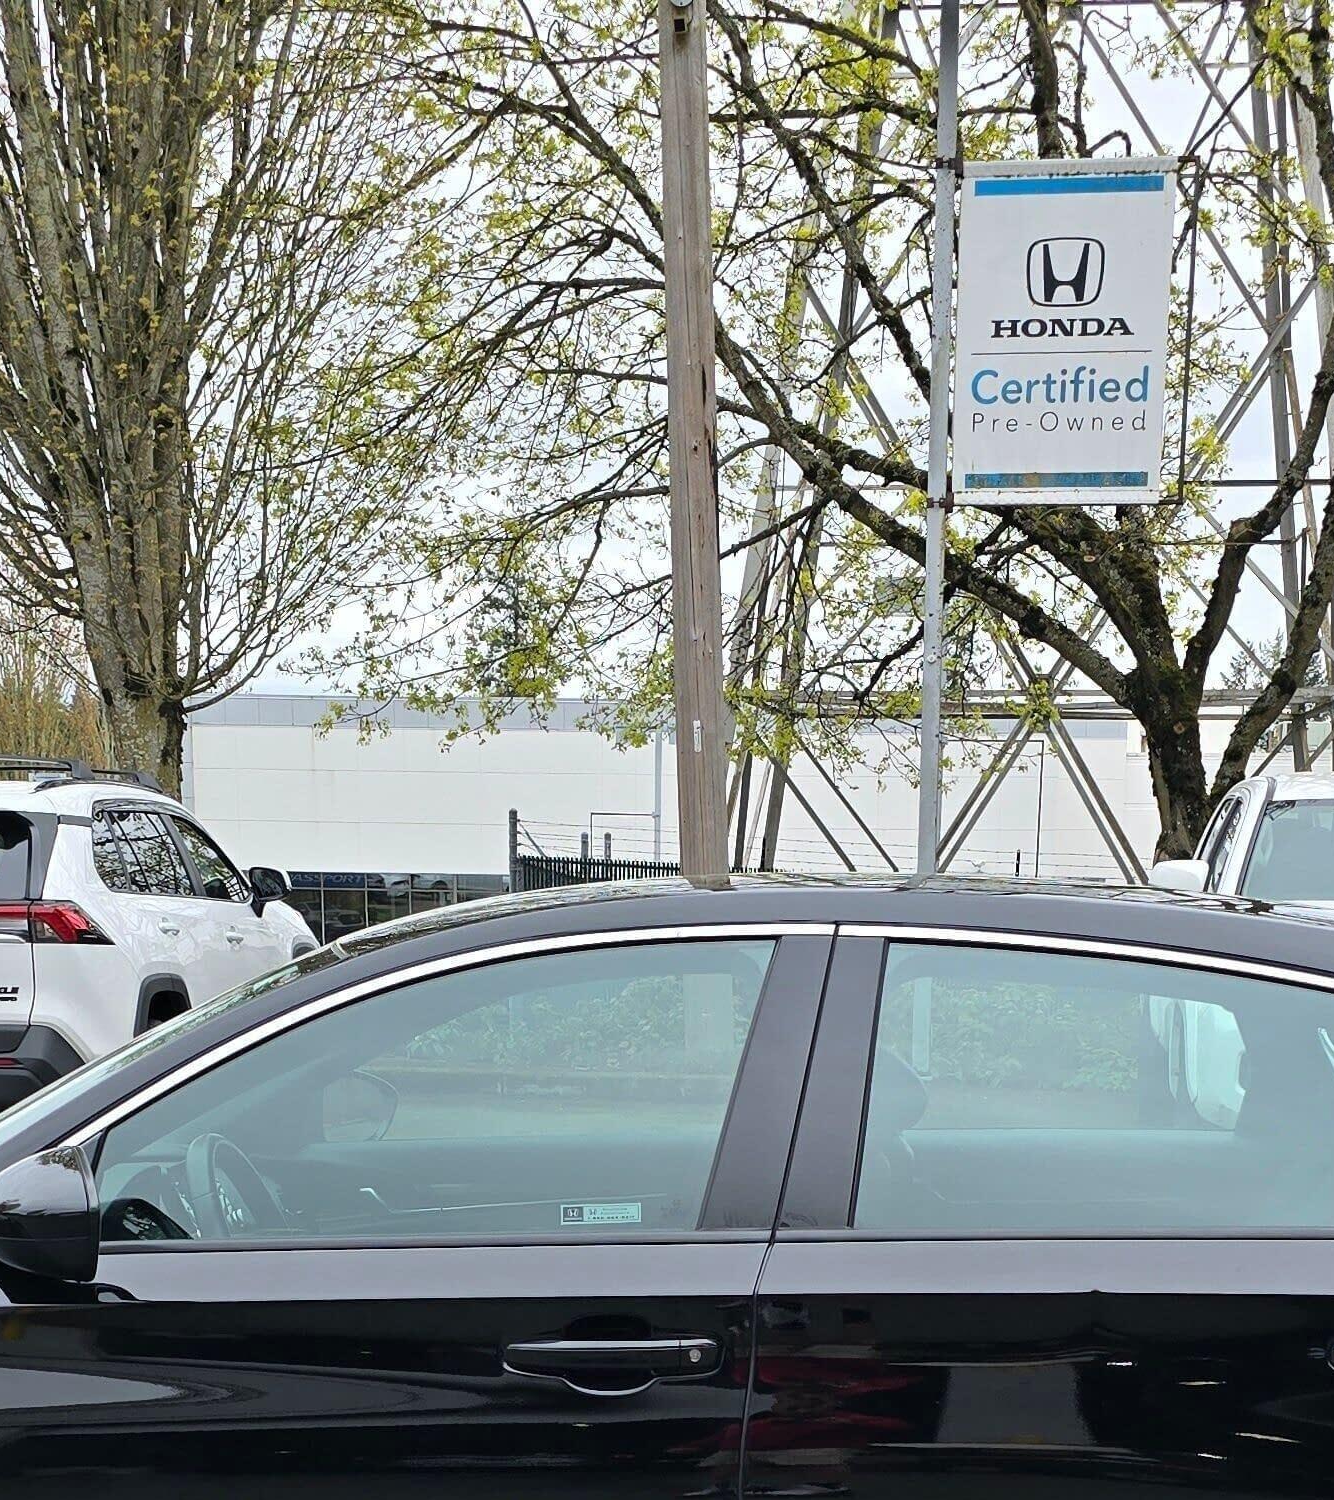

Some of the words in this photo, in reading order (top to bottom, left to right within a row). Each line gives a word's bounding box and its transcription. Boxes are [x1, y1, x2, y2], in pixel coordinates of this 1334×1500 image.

[991, 317, 1134, 338] HONDA
[971, 365, 1149, 405] Certified
[971, 409, 1147, 433] Pre-Owned
